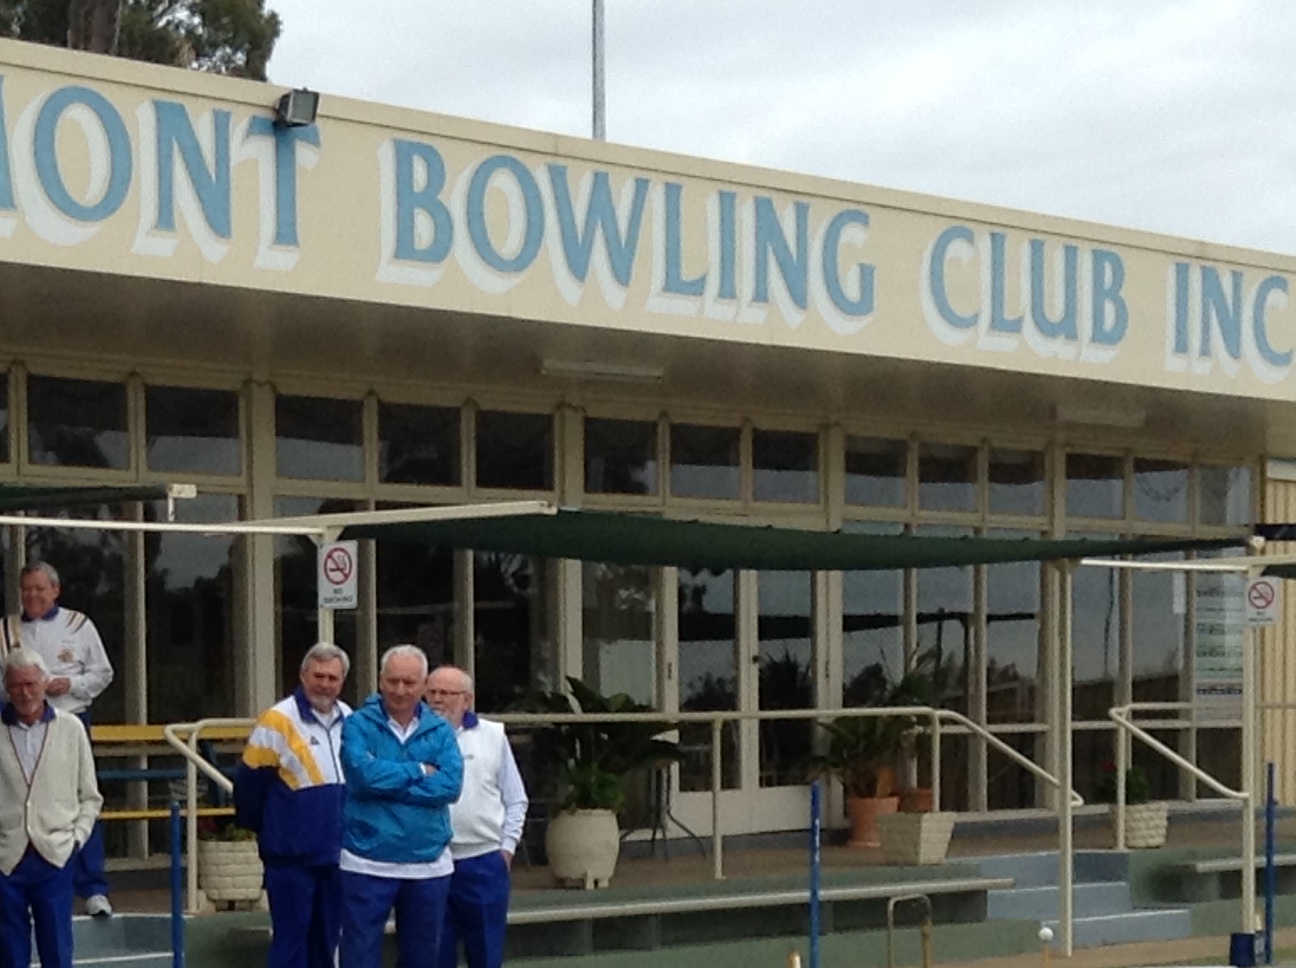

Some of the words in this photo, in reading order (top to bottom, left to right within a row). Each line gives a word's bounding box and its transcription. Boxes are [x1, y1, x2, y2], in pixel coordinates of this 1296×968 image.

[380, 138, 876, 331] BOWLING
[922, 226, 1130, 360] CLUB
[1167, 263, 1294, 381] INC
